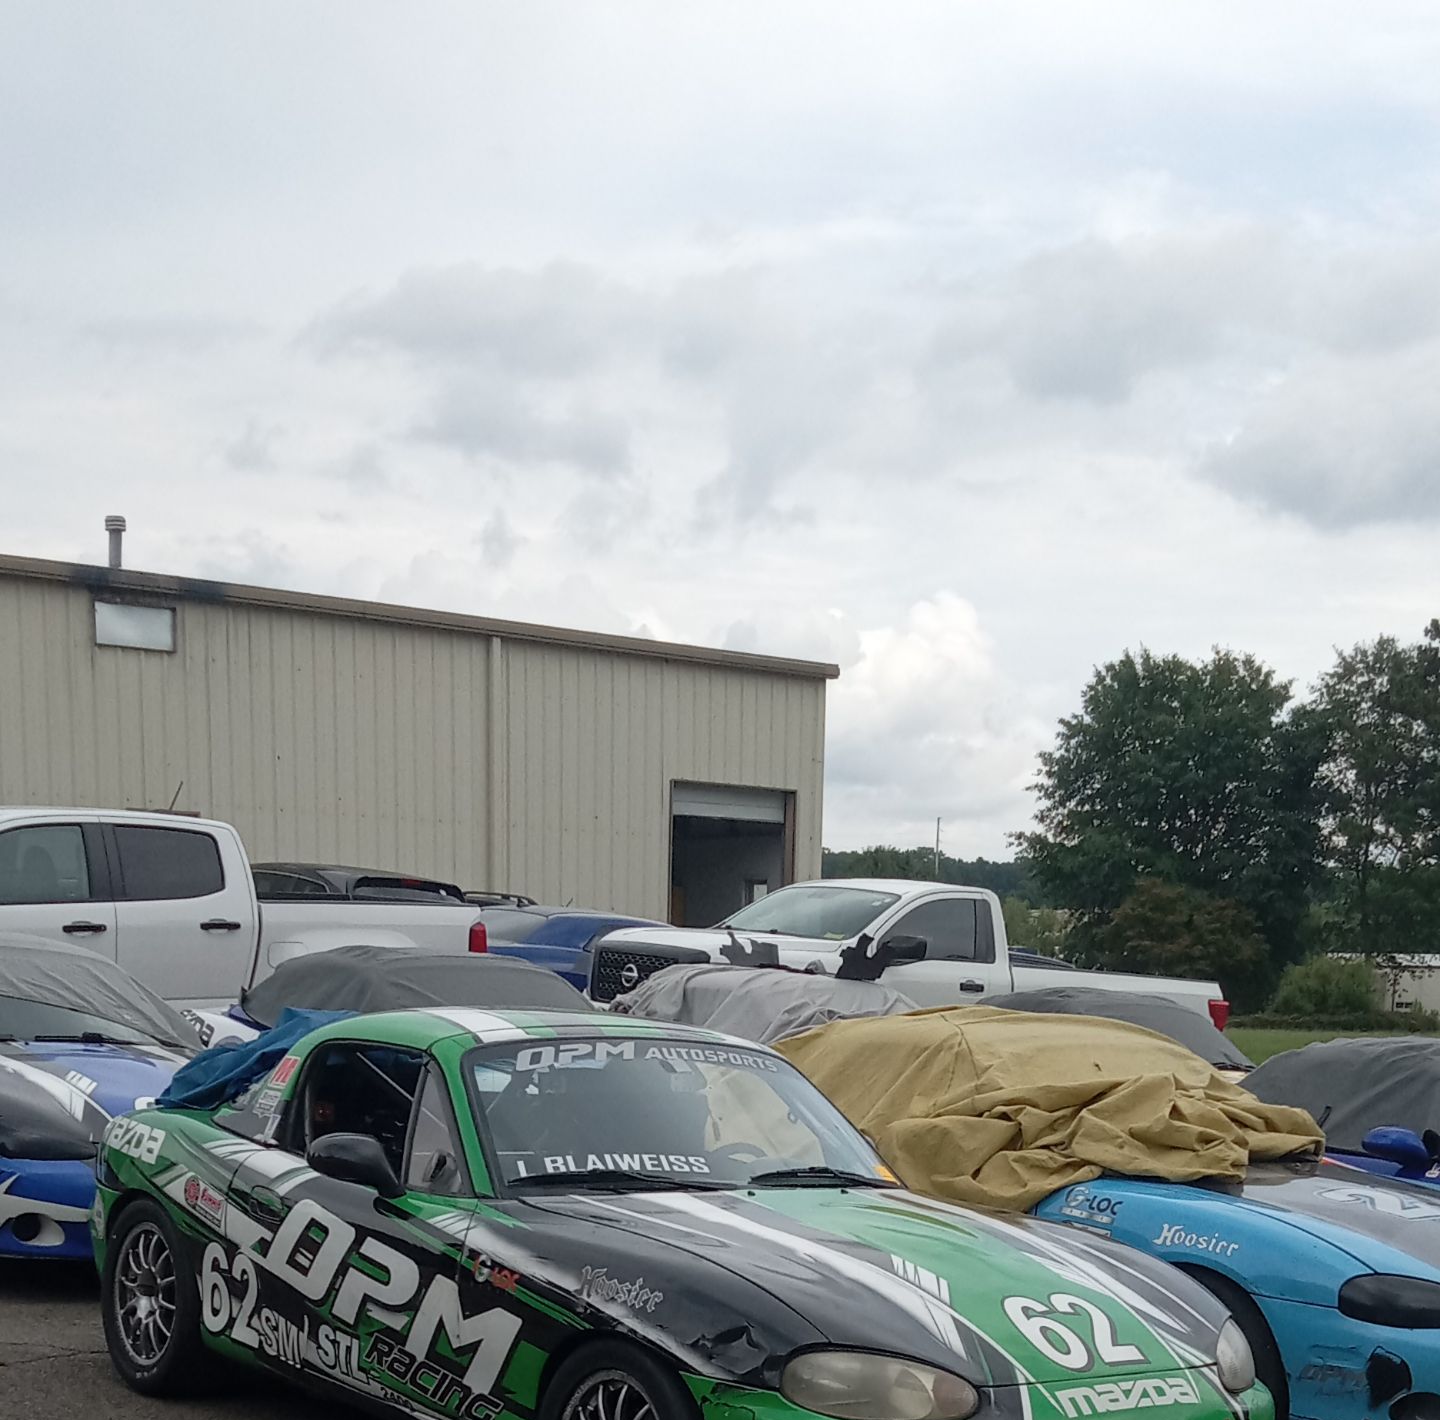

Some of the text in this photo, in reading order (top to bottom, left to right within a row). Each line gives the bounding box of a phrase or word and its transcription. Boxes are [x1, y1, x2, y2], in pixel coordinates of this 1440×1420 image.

[644, 1046, 778, 1073] AUTOSPORTS
[544, 1153, 710, 1174] BLAIWEISS
[1065, 1186, 1124, 1216] G-LOC
[1152, 1223, 1239, 1257] Hoosier
[267, 1199, 523, 1395] OPM
[571, 1265, 664, 1313] Hoosier
[202, 1241, 260, 1349] 62
[317, 1324, 369, 1385] STL
[1002, 1293, 1150, 1372] 62
